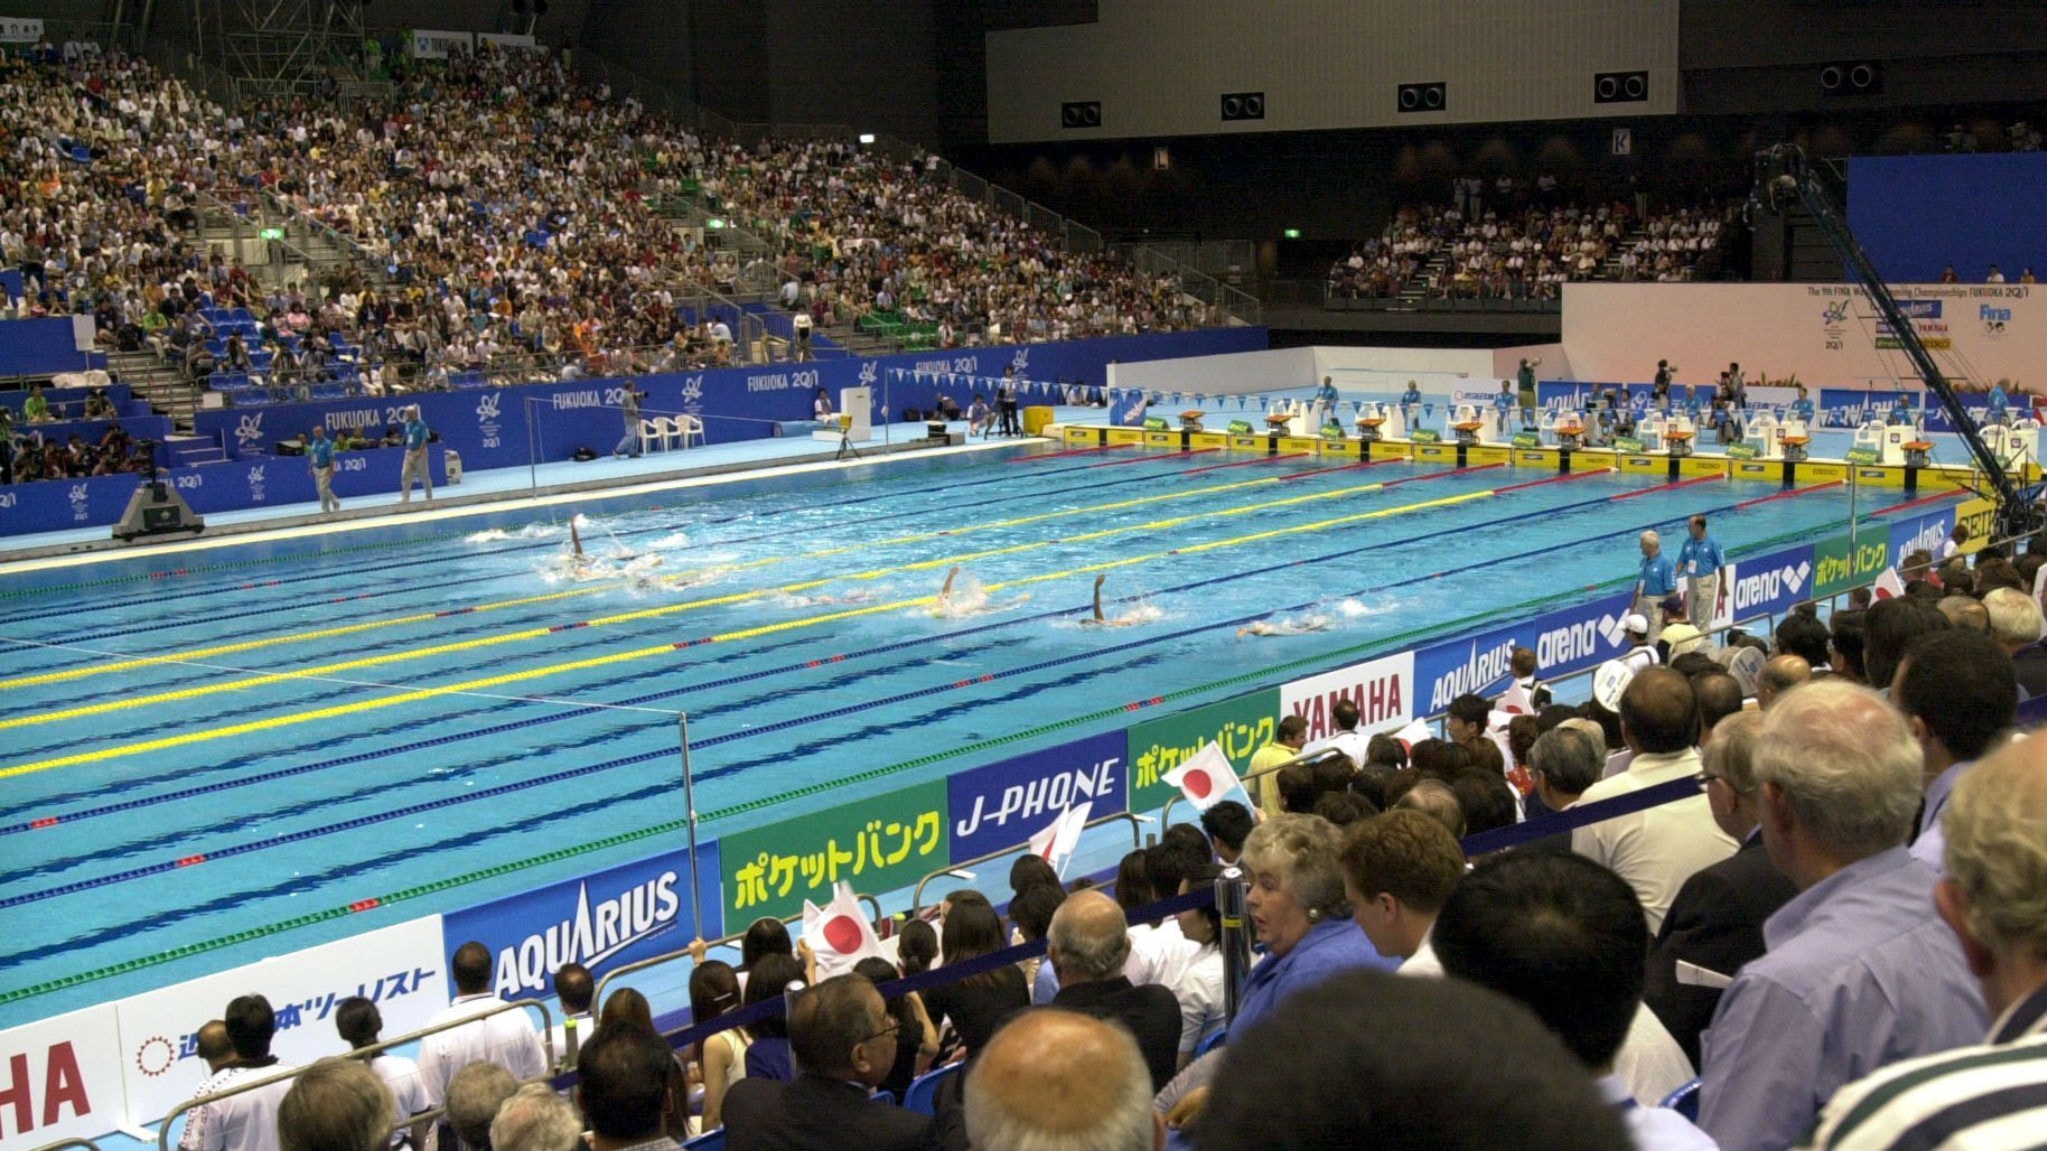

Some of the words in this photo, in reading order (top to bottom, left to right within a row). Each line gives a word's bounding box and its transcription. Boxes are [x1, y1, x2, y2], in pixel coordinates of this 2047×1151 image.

[1157, 151, 1167, 169] L
[1615, 135, 1628, 153] K
[552, 390, 601, 410] FUKUOKA
[747, 374, 788, 393] FUKUOKA
[325, 409, 381, 432] FUKUOKA
[1735, 570, 1781, 610] arena
[1537, 619, 1596, 669] arena
[1430, 638, 1516, 713] AQUARIUS
[956, 757, 1120, 837] J-PHONE
[735, 810, 939, 909] ポケットバンク
[494, 871, 679, 999] AQUARIUS
